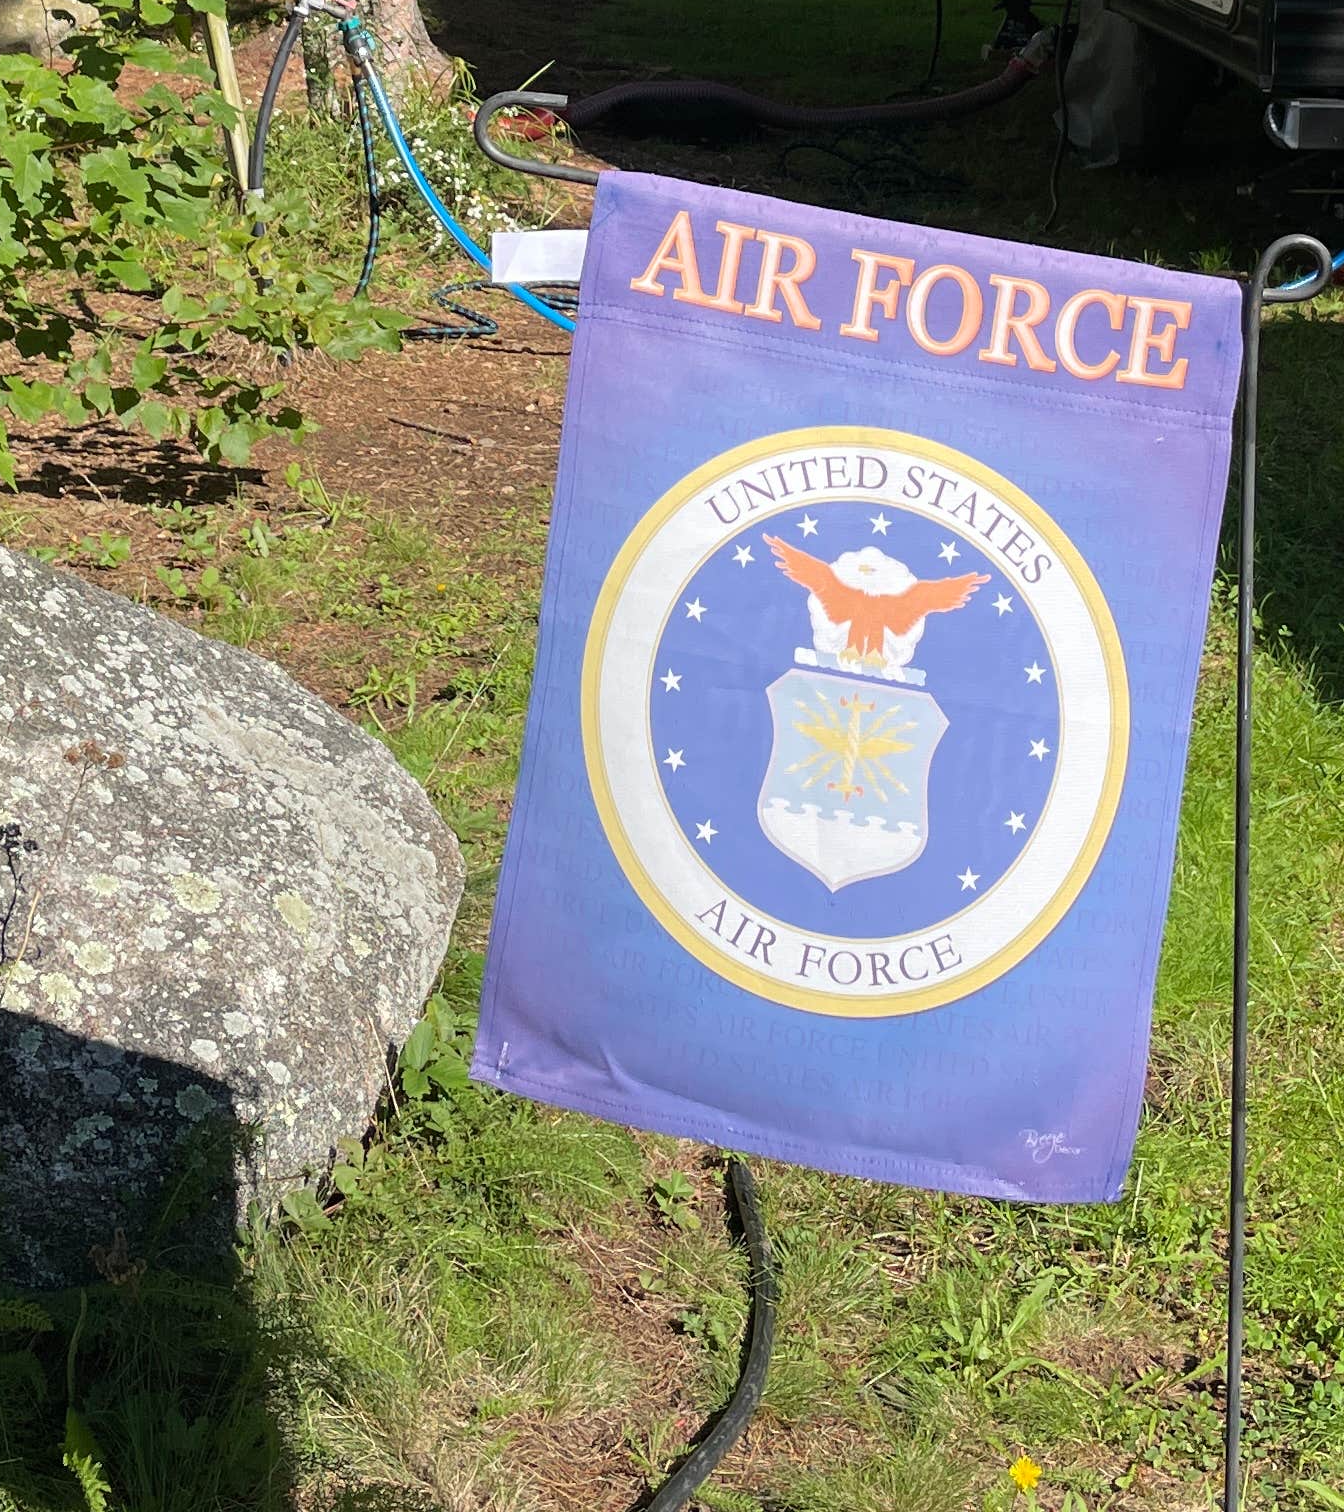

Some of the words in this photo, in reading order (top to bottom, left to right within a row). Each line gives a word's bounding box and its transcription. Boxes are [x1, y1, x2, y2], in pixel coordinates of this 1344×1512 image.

[630, 210, 822, 331] AIR
[839, 248, 1192, 390] FORCE
[704, 455, 889, 525] UNITED
[901, 464, 1054, 585] STATES
[695, 899, 778, 967] AIR
[795, 934, 964, 987] FORCE
